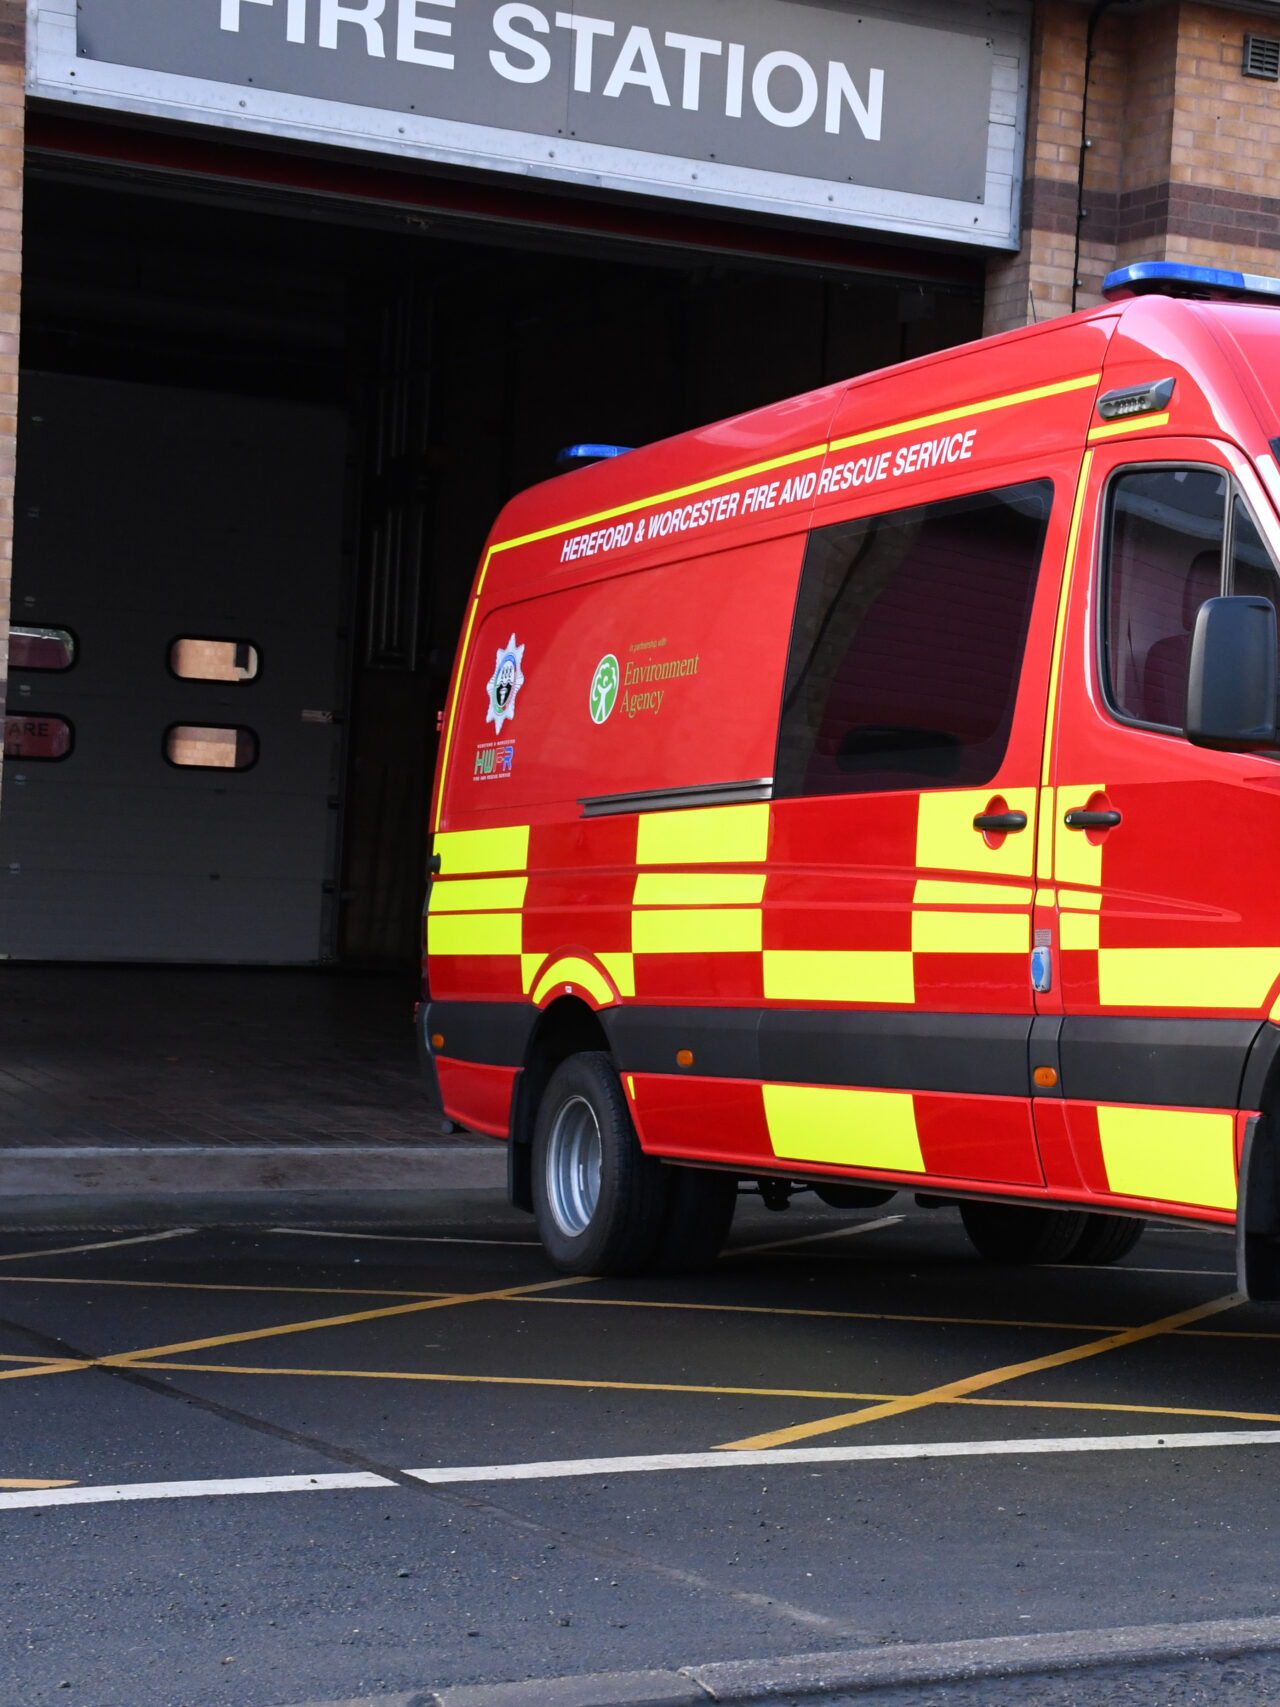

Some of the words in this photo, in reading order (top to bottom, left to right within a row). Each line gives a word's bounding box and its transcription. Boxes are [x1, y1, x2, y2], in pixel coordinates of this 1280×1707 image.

[488, 1, 885, 141] STATION
[560, 522, 634, 563] HEREFORD
[634, 519, 646, 544] &
[647, 492, 740, 540] WORCESTER
[740, 481, 780, 515] FIRE
[778, 472, 816, 505] AND
[817, 451, 891, 495] RESCUE
[892, 429, 977, 477] SERVICE
[624, 654, 699, 686] Environment
[620, 689, 664, 719] Agency
[474, 746, 513, 776] HWFR
